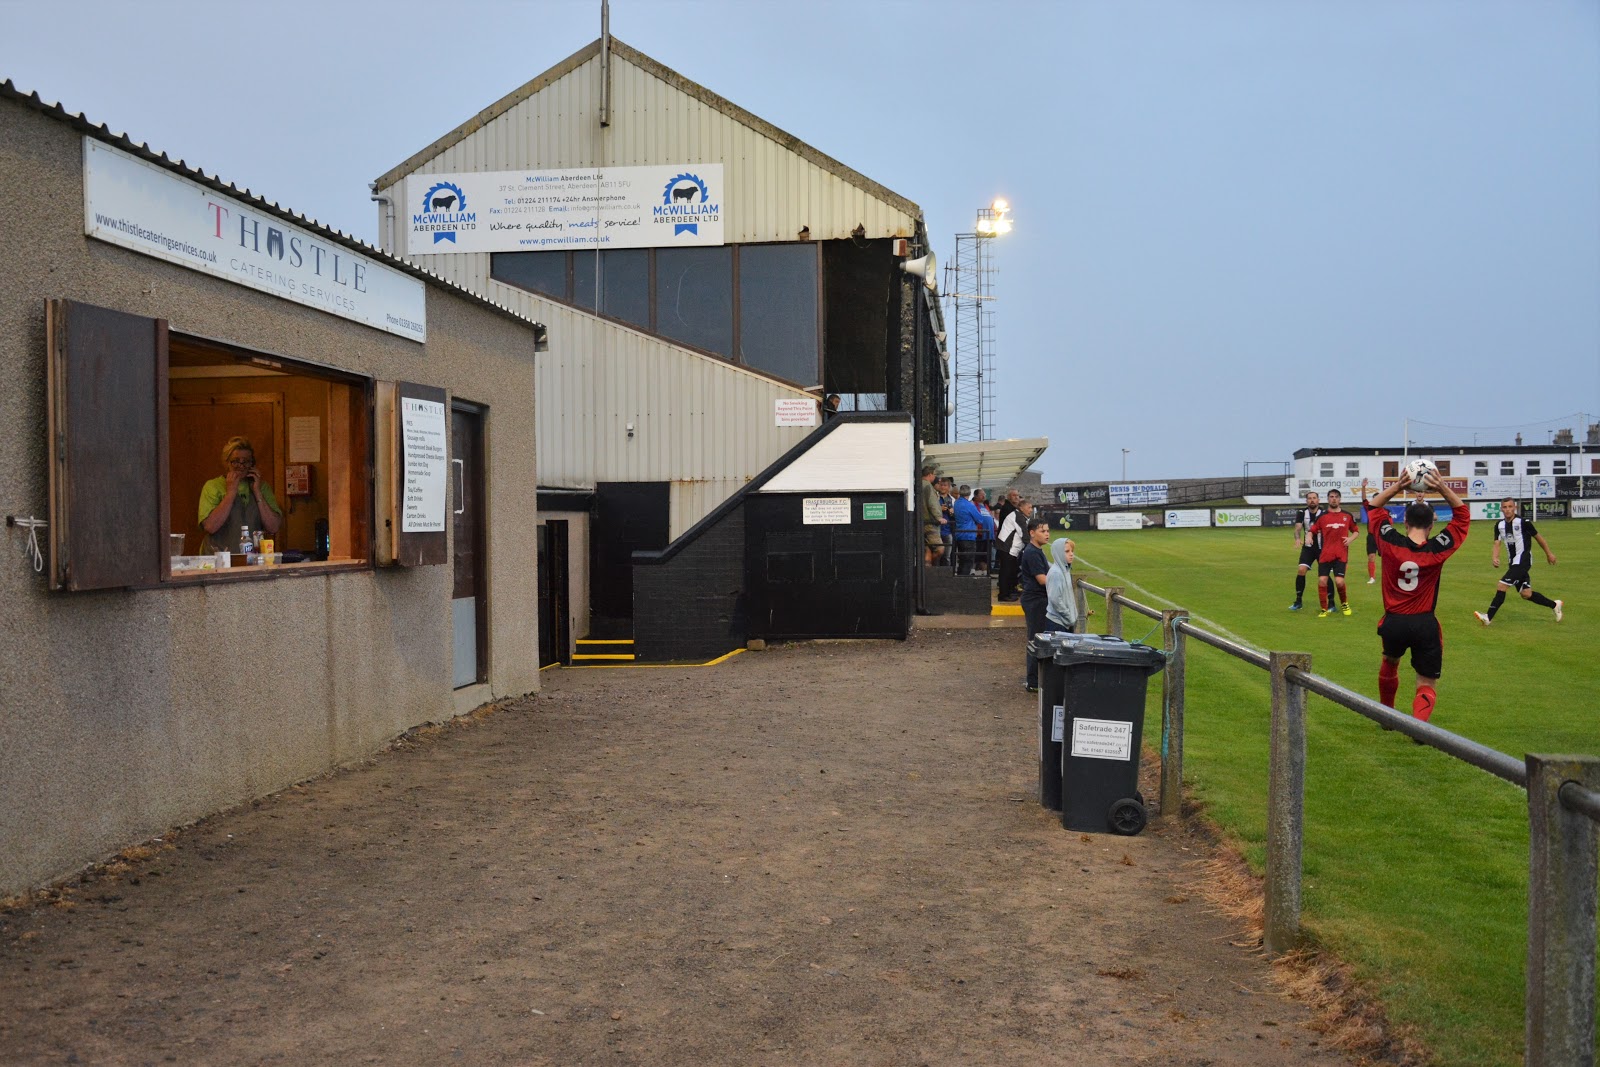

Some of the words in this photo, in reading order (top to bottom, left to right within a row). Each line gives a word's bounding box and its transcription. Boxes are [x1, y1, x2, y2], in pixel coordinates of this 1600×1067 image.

[582, 194, 626, 203] Answerphone
[654, 204, 718, 215] McWILLIAM
[414, 213, 476, 224] McWILLIAM
[490, 222, 522, 230] Where
[526, 219, 563, 232] quality
[604, 217, 641, 228] service!
[95, 212, 217, 263] www.thistlecateringservices.co.uk
[519, 235, 610, 246] www.gmcwilliam.co.uk
[230, 258, 295, 290] CATERING
[302, 283, 355, 311] SERVICES
[386, 313, 398, 326] Phone
[1312, 480, 1341, 488] flooring
[1524, 502, 1564, 510] vitoria
[1229, 513, 1260, 522] brakes
[1398, 561, 1419, 592] 3
[1079, 724, 1112, 732] Safetrade
